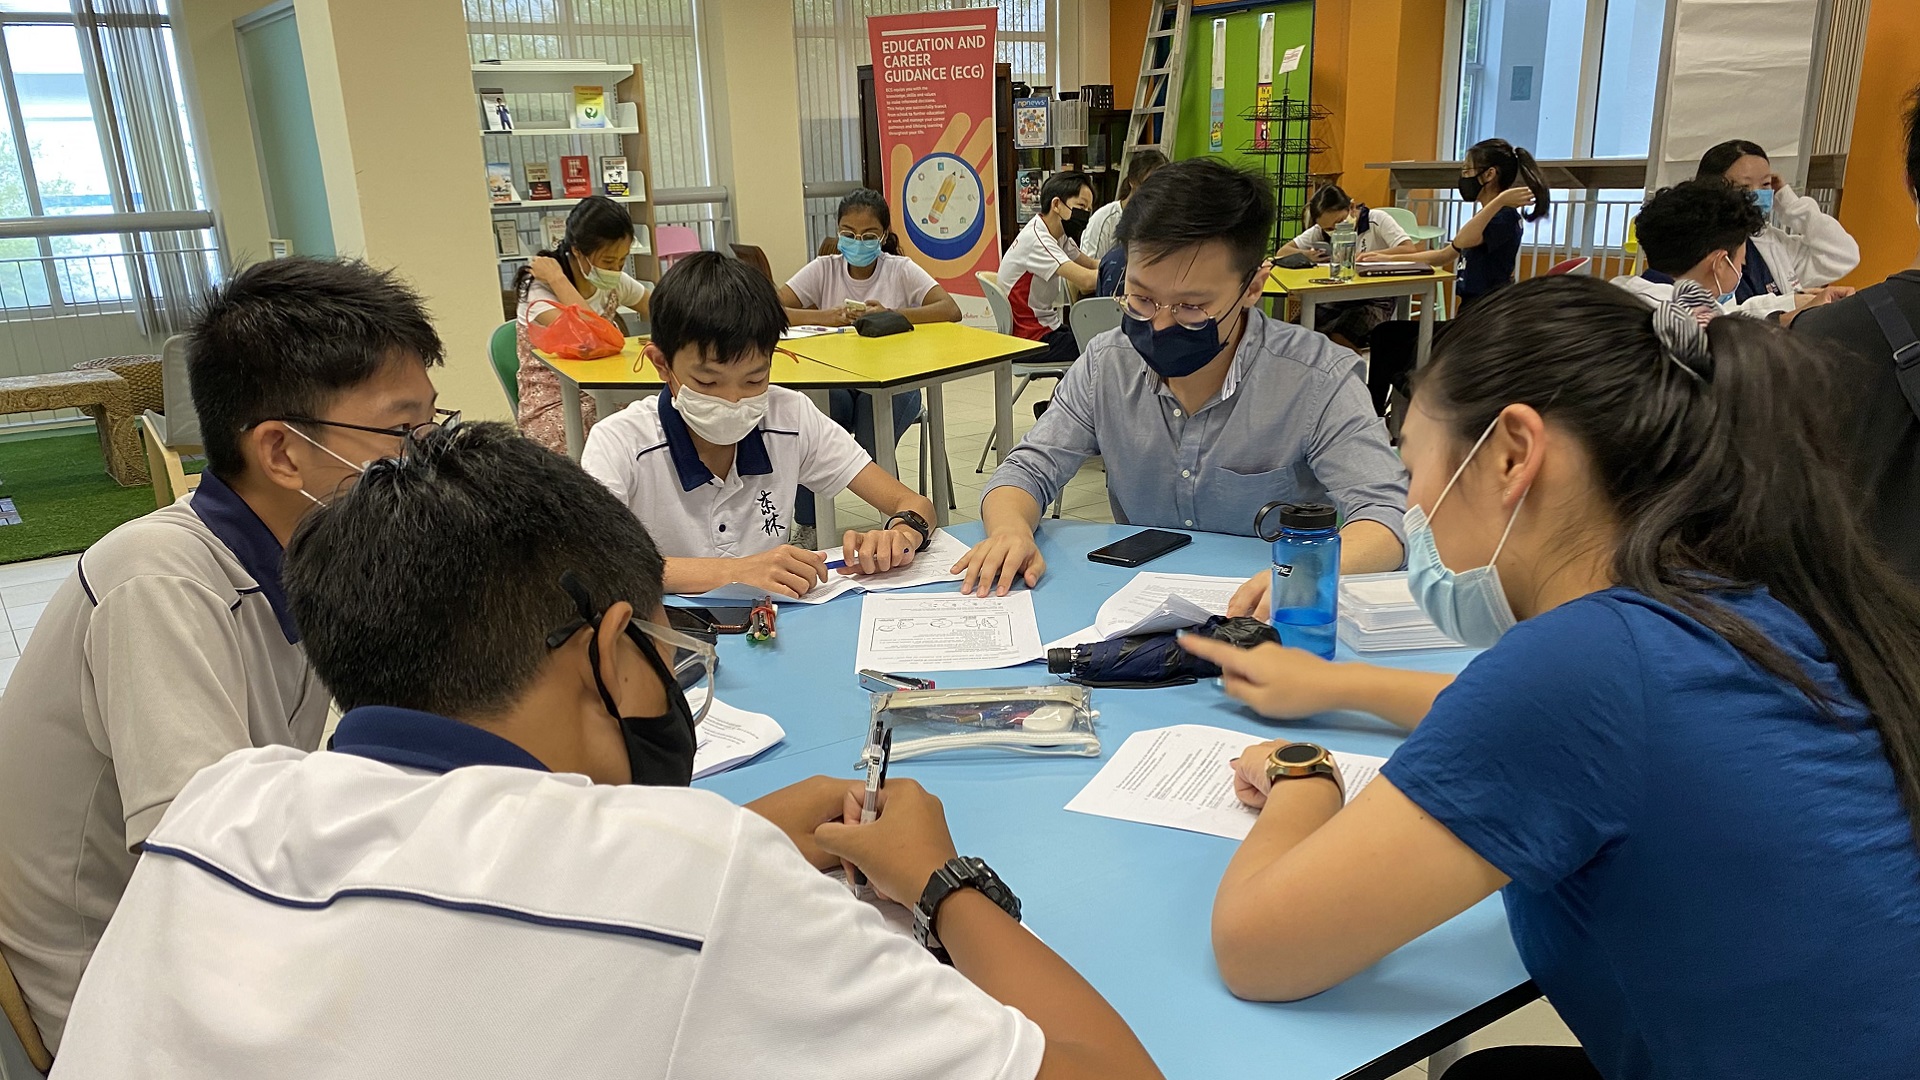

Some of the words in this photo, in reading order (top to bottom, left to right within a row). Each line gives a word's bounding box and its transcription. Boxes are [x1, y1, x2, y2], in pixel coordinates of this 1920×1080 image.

[882, 37, 953, 54] EDUCATION
[958, 35, 986, 49] AND
[884, 53, 931, 68] CAREER
[885, 67, 946, 83] GUIDANCE
[951, 64, 984, 80] (ECG)
